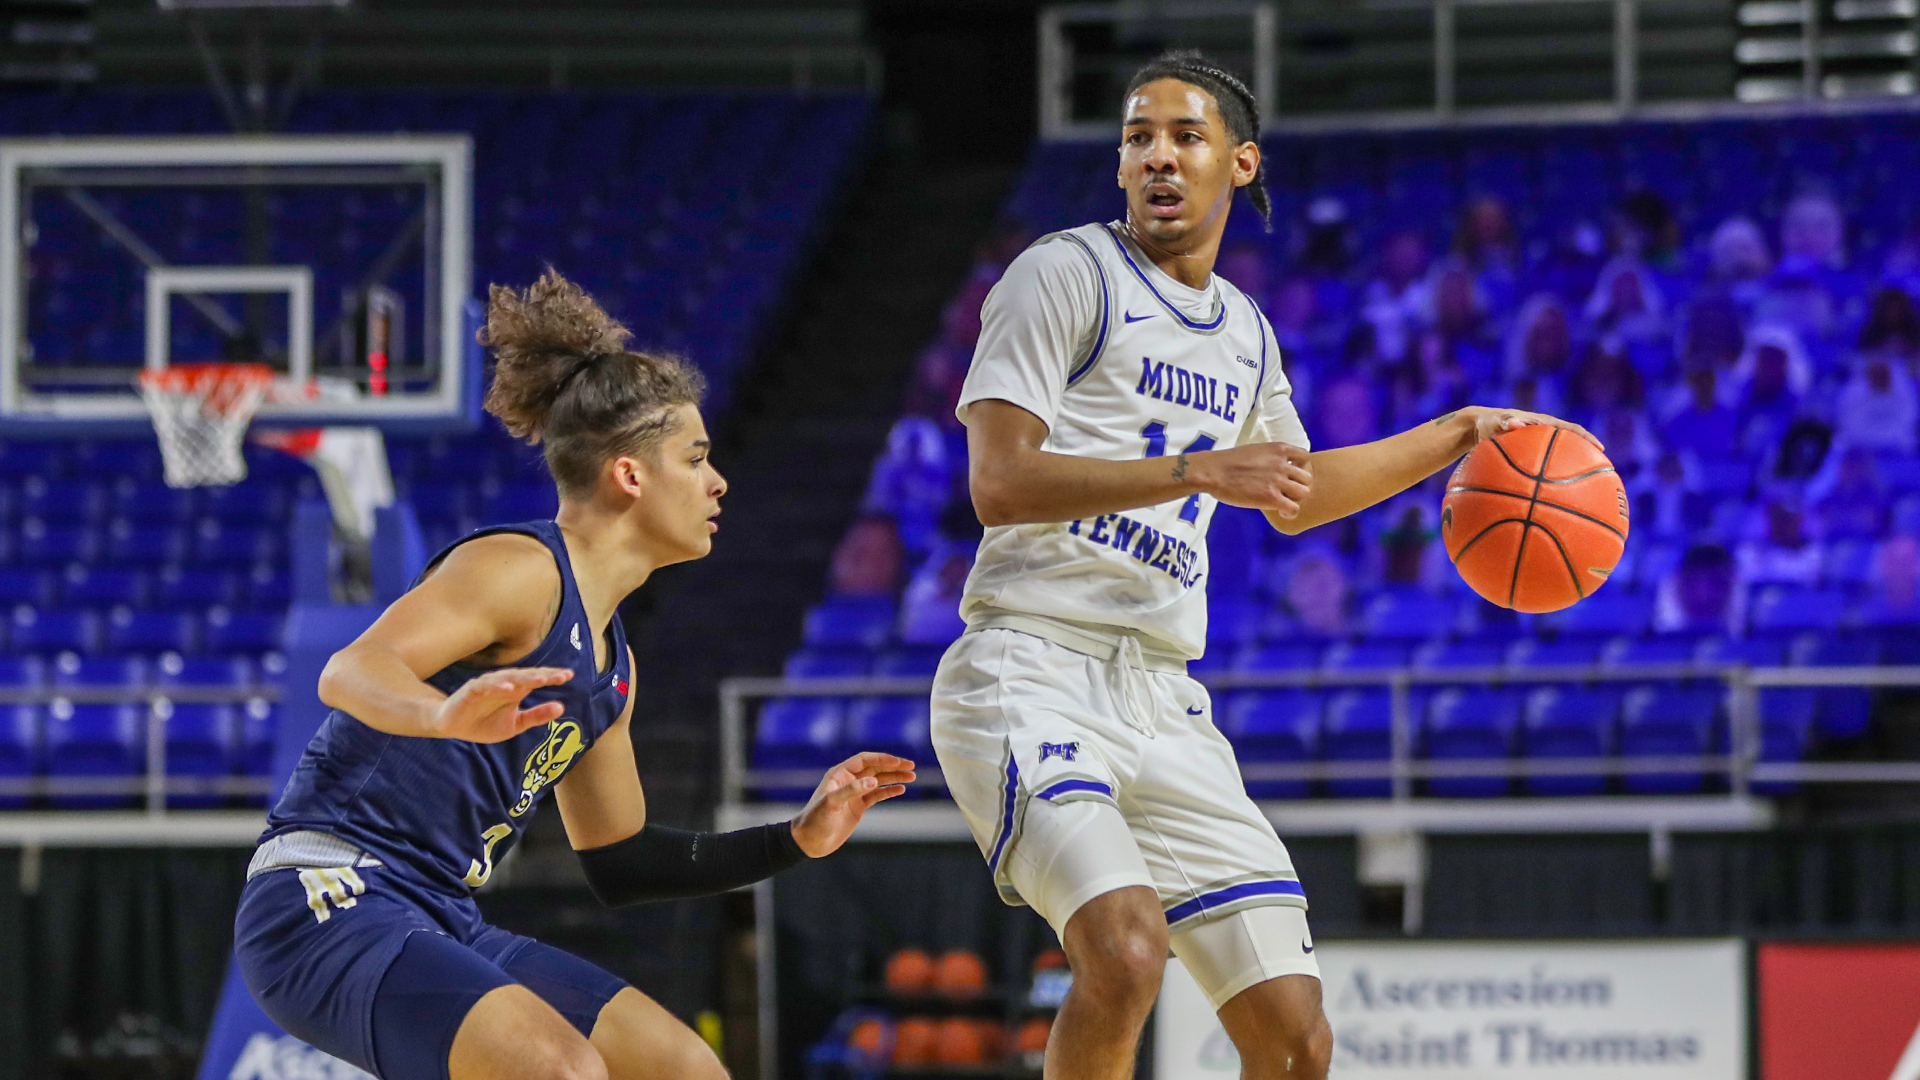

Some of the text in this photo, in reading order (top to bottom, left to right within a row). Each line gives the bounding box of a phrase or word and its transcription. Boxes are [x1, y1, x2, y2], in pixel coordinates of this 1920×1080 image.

[1236, 355, 1258, 370] C-USA
[1136, 357, 1239, 424] MIDDLE
[462, 823, 513, 887] 3
[1336, 966, 1612, 1010] Ascension
[1334, 1023, 1700, 1066] Saint Thomas
